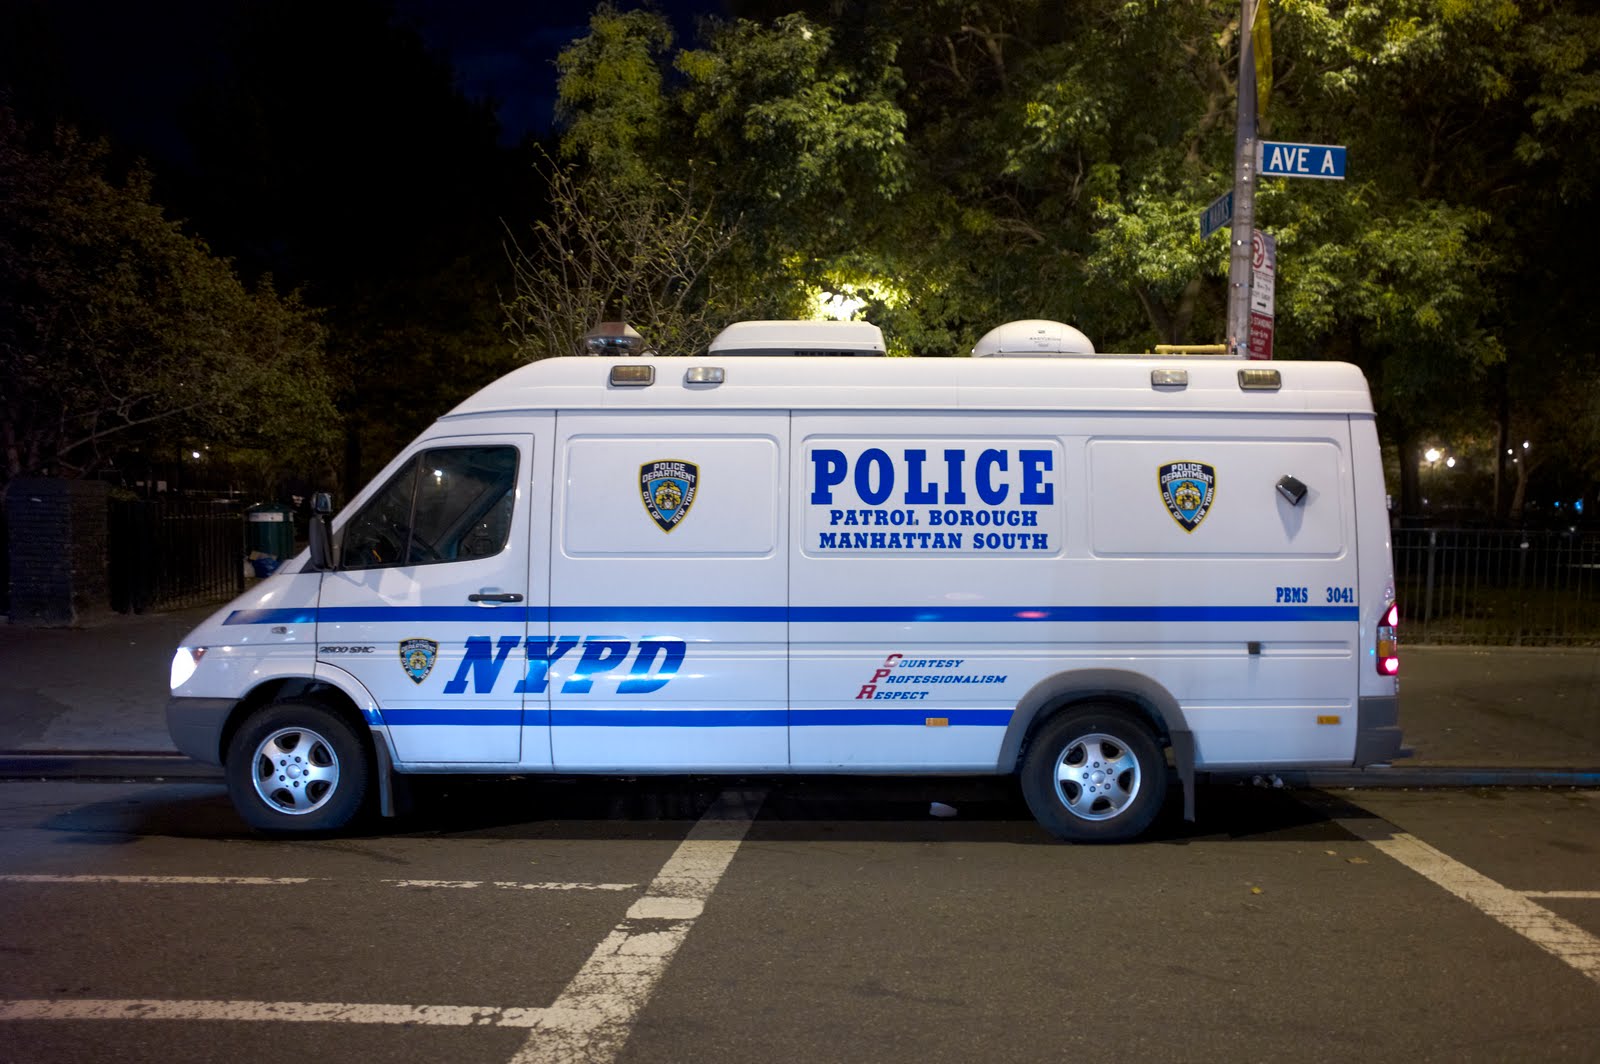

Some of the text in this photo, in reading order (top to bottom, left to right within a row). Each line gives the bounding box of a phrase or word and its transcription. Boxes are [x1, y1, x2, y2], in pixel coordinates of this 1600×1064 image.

[1269, 147, 1335, 174] AVE A
[642, 469, 696, 483] DEPARTMENT
[653, 462, 686, 472] POLICE
[1171, 463, 1203, 473] POLICE
[811, 447, 1055, 506] POLICE
[1161, 470, 1213, 484] DEPARTMENT
[643, 491, 661, 520] CITY OF
[671, 487, 695, 524] NEW YORK
[1163, 491, 1183, 520] CITY OF
[1193, 487, 1214, 524] NEW YORK
[829, 509, 1038, 526] PATROL BOROUGH
[819, 532, 1049, 550] MANHATTAN SOUTH
[1275, 586, 1354, 604] PBMS 3041
[442, 635, 686, 694] NYPD
[883, 653, 964, 668] COURTESY
[869, 669, 1008, 684] PROFESSIONALISM
[855, 684, 929, 700] RESPECT
